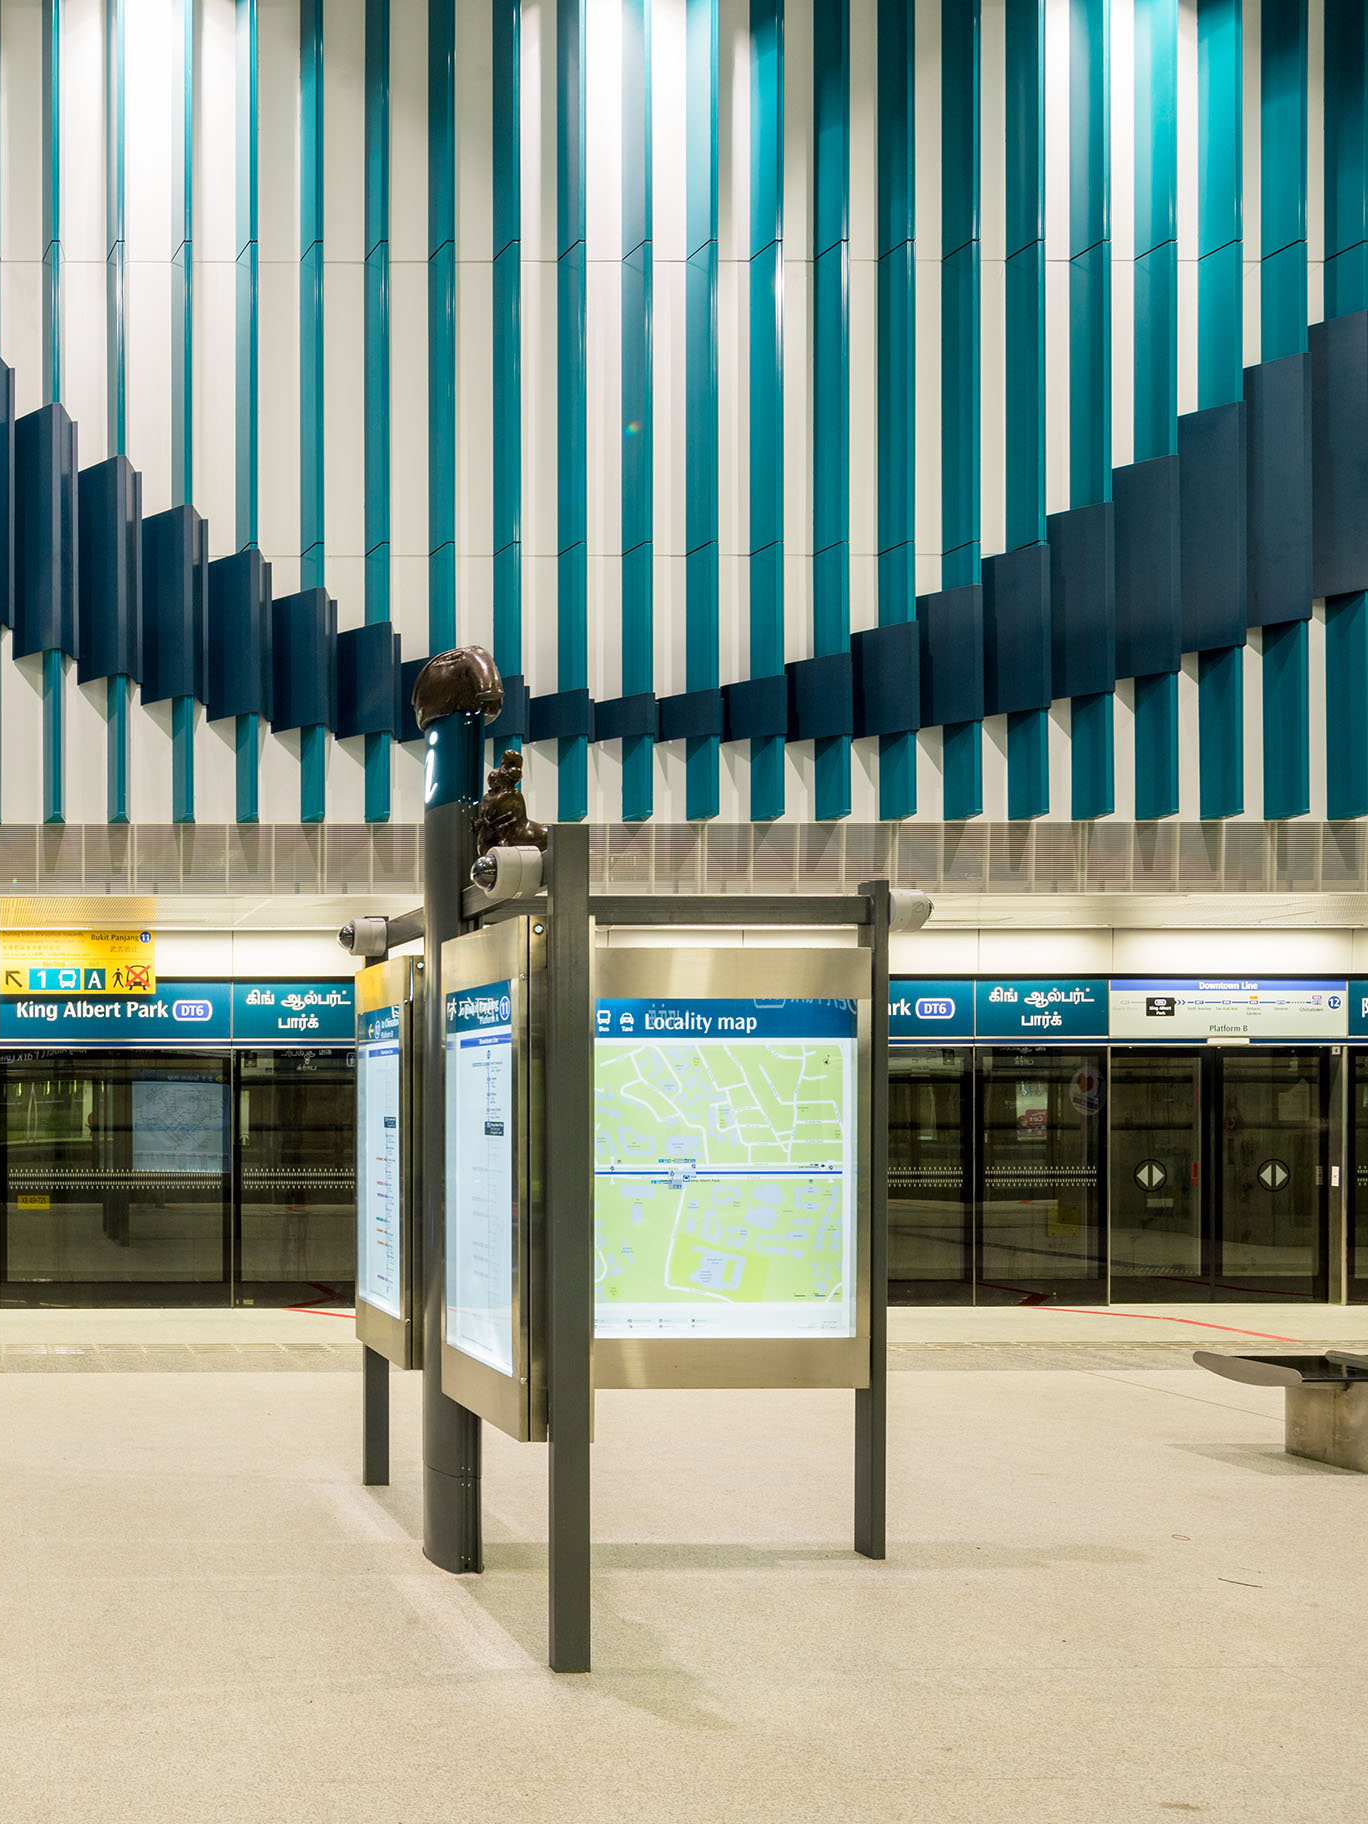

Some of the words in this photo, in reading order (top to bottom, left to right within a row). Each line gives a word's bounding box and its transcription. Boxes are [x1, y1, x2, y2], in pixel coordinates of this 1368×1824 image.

[111, 934, 139, 942] Panjang
[37, 970, 46, 988] 1
[88, 970, 102, 989] A
[1199, 981, 1240, 990] Downtown
[1241, 981, 1258, 990] Line
[246, 989, 275, 1005] கிங்
[988, 986, 1018, 1002] கிங்
[16, 1001, 56, 1022] King
[63, 1001, 121, 1018] Albert
[127, 1001, 169, 1018] Park
[181, 1005, 204, 1017] DT6
[889, 999, 911, 1016] rk
[924, 1003, 947, 1014] DT6
[278, 1013, 319, 1031] பார்க்
[645, 1012, 712, 1033] Locality
[718, 1015, 758, 1033] map
[1021, 1011, 1062, 1029] பார்க்
[1209, 1024, 1241, 1032] Platform
[1243, 1024, 1248, 1032] B
